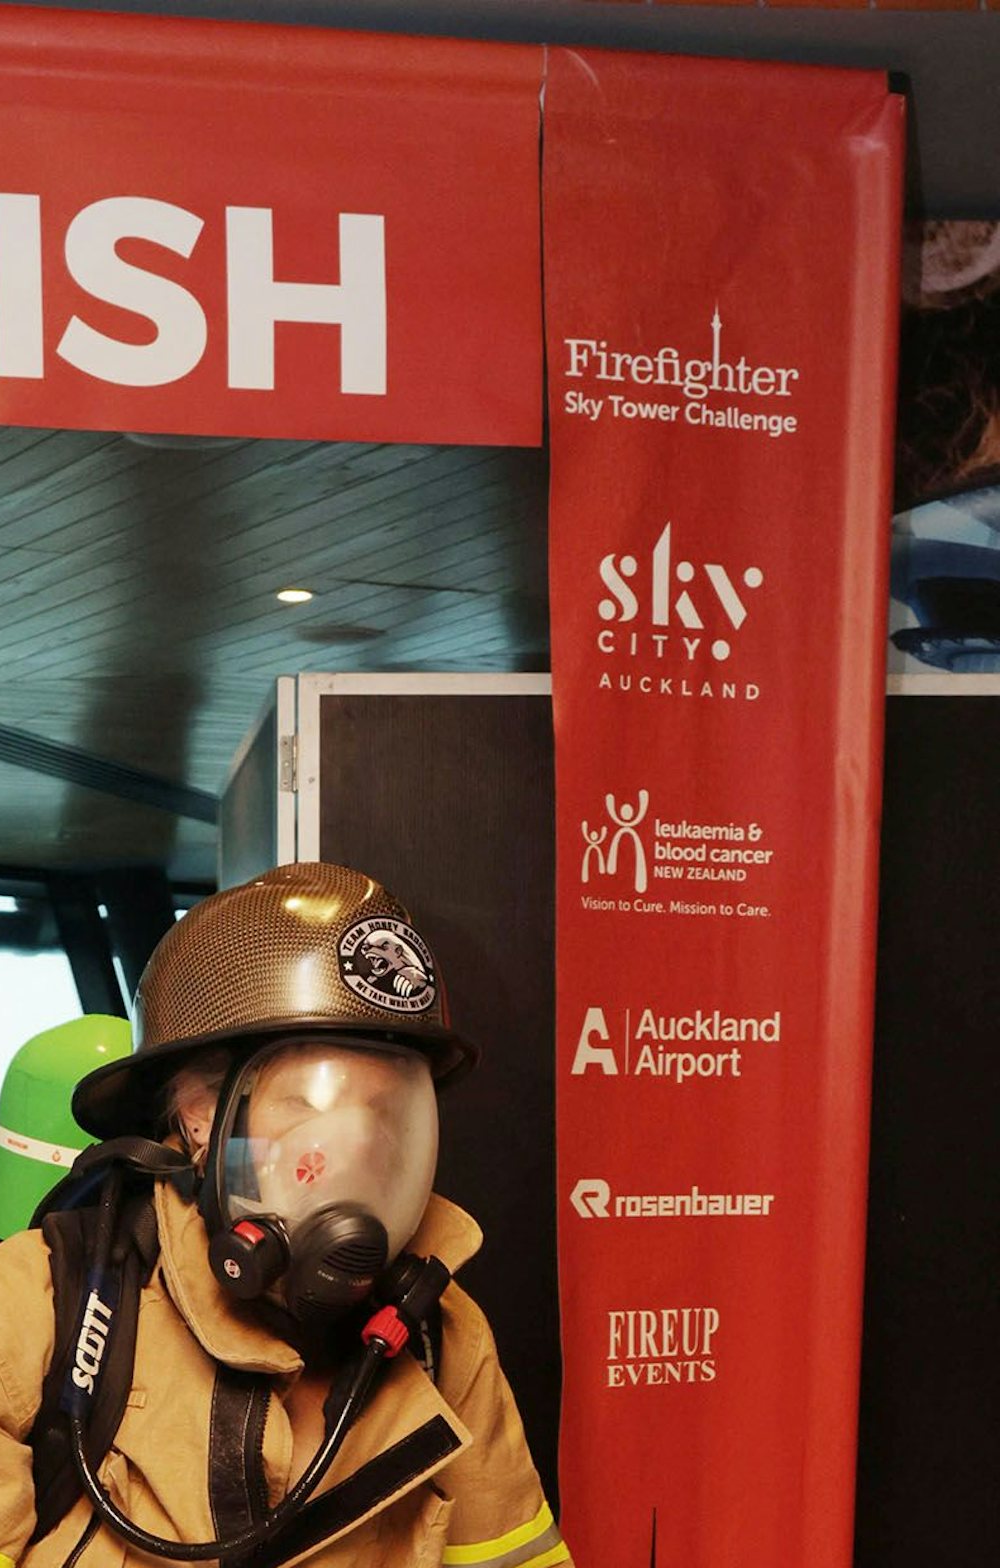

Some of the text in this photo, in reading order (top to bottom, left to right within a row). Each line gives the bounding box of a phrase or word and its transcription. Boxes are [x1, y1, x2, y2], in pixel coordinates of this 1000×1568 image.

[563, 312, 800, 399] Firefighter
[564, 390, 797, 437] Sky Tower Challenge
[597, 629, 701, 661] CITY
[598, 672, 760, 701] AUCKLAND
[654, 819, 763, 842] leukaemia &
[654, 842, 773, 865] blood cancer
[653, 866, 747, 882] NEW ZEALAND
[580, 896, 772, 918] Vision to Cure. Mission to Care.
[342, 926, 366, 951] TEAM
[635, 1008, 781, 1042] Auckland
[634, 1044, 742, 1084] Airport
[615, 1185, 775, 1218] rosenbauer
[71, 1291, 113, 1396] SCOTT
[606, 1307, 720, 1361] FIREUP
[606, 1359, 717, 1388] EVENTS
